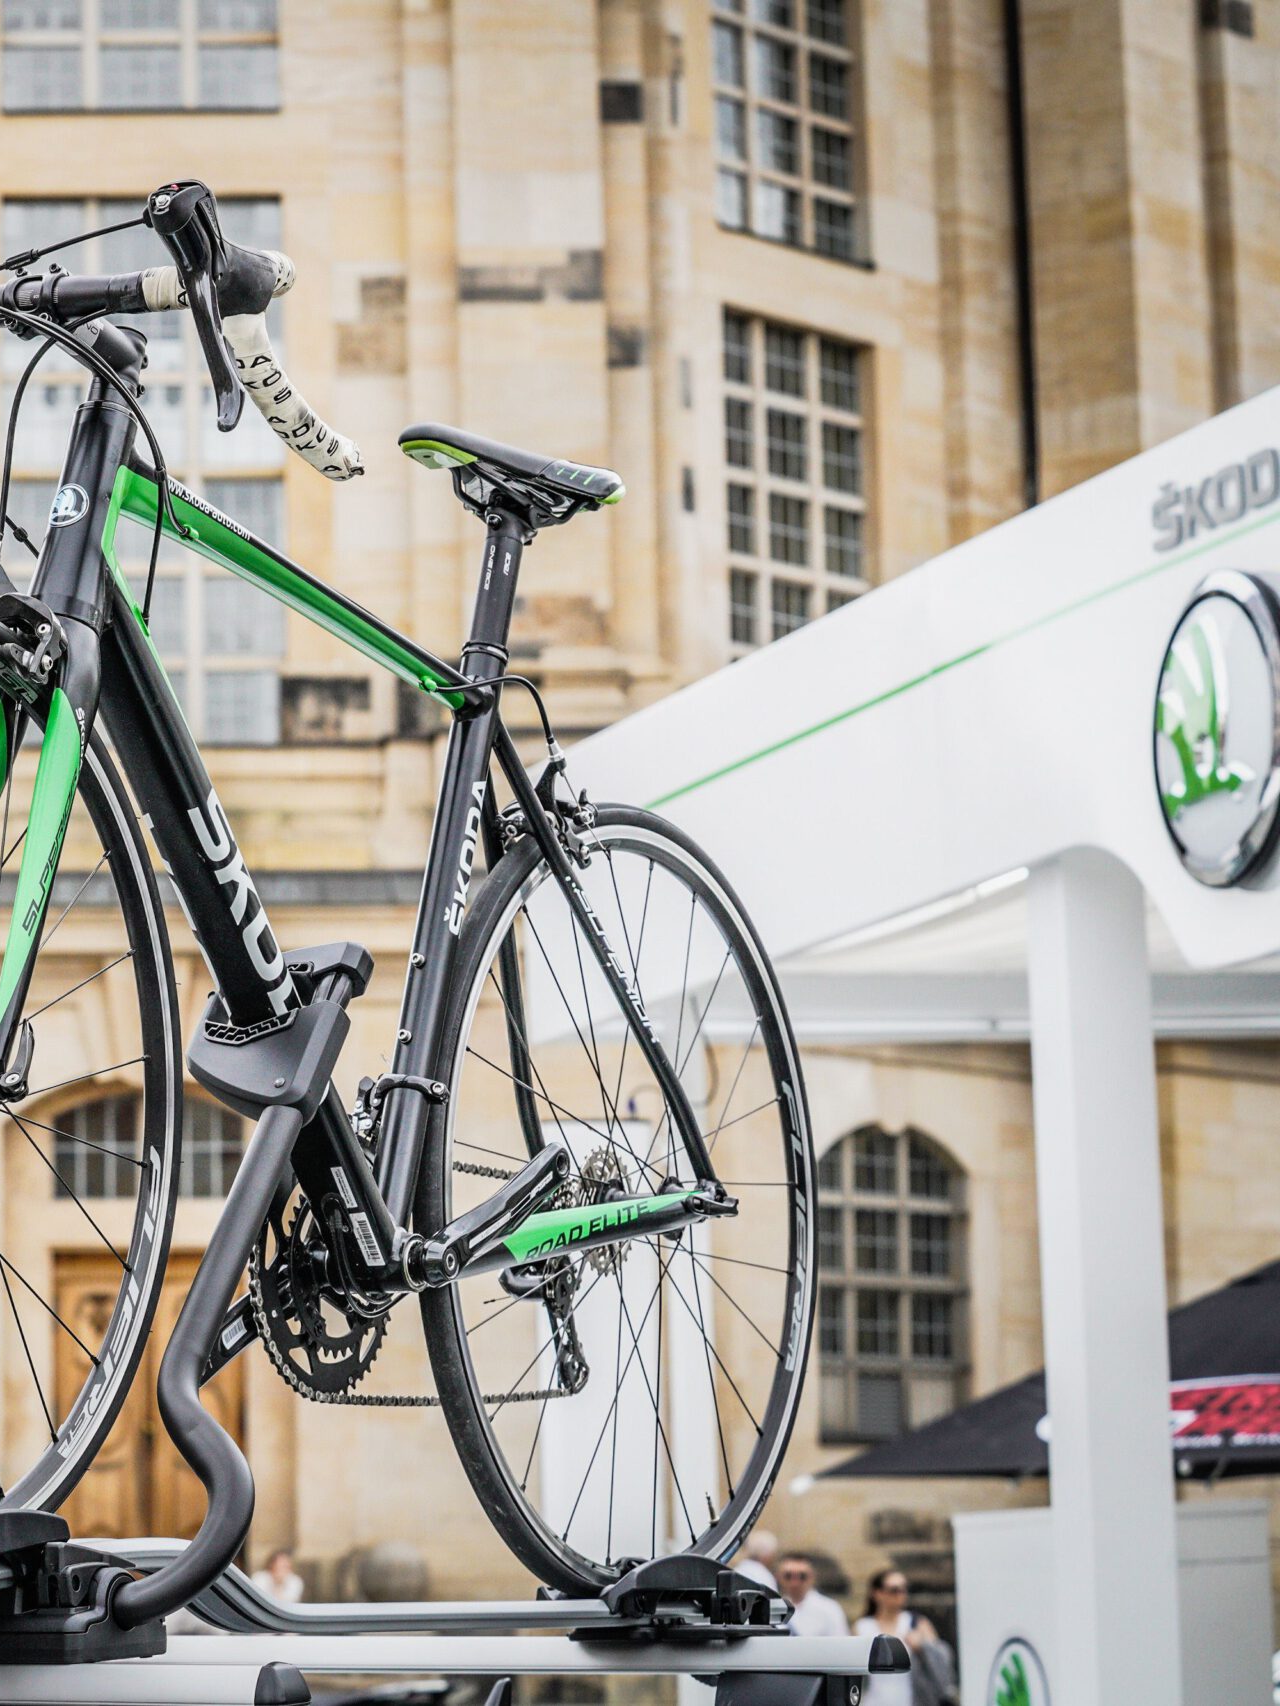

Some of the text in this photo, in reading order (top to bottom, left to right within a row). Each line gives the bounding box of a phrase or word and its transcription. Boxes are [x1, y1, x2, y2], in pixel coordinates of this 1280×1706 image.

[444, 780, 487, 938] ŠKODA
[526, 1224, 583, 1259] ROAD
[589, 1200, 650, 1233] ELITE
